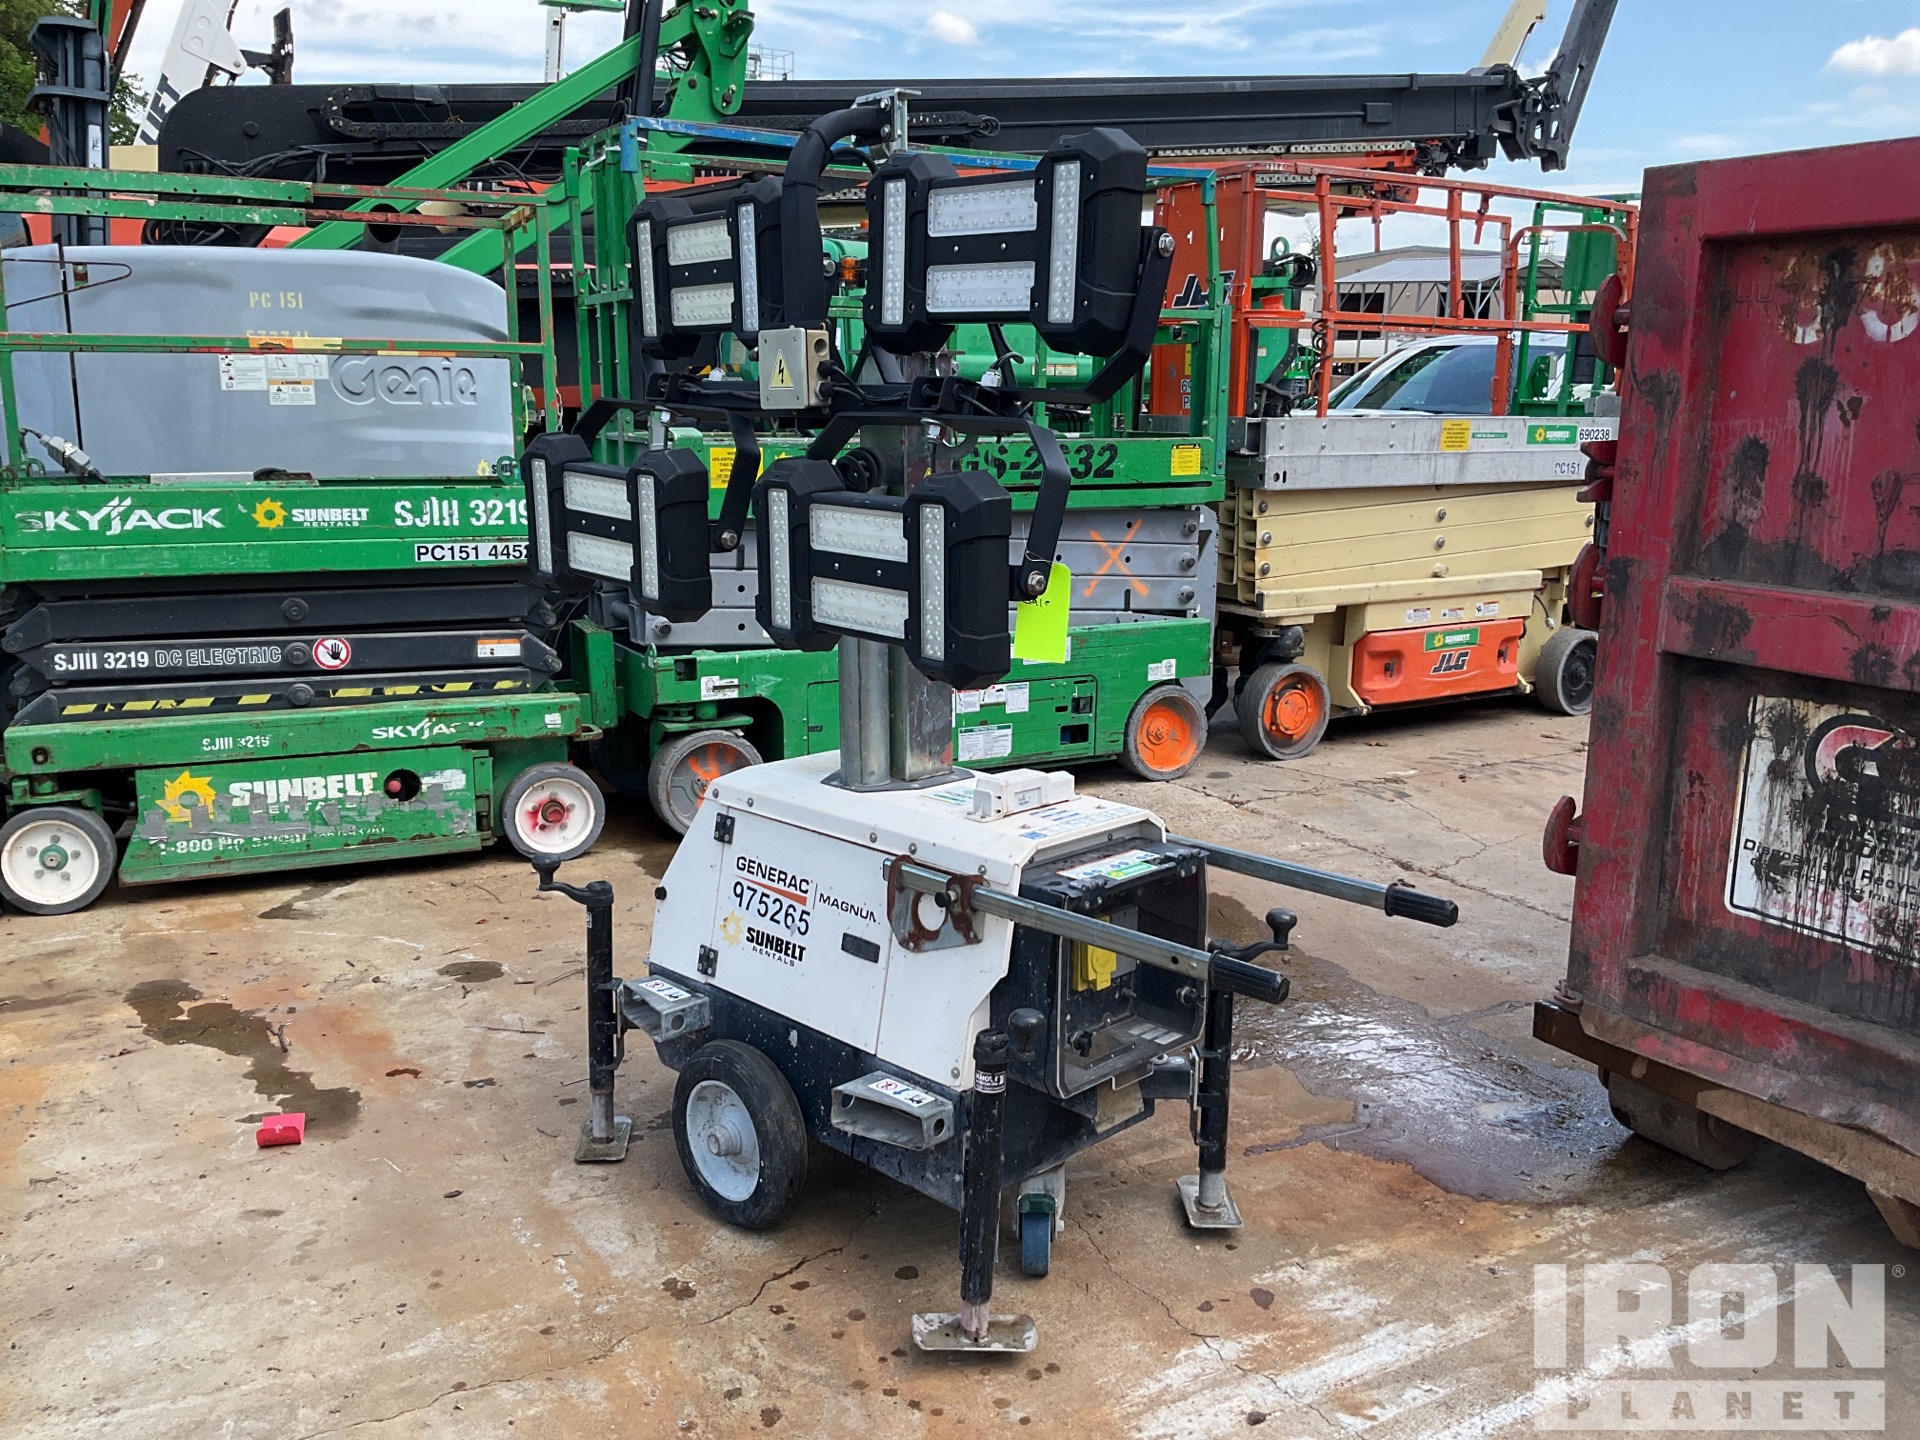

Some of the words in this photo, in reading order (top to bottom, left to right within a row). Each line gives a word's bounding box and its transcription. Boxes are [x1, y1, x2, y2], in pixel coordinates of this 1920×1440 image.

[249, 291, 271, 309] PC
[280, 292, 304, 309] 151
[330, 354, 478, 406] Genie
[1579, 428, 1611, 441] 690238
[14, 496, 226, 536] SKYJACK
[291, 507, 369, 522] SUNBELT
[416, 544, 480, 562] PC151
[53, 652, 98, 671] SJIII
[103, 649, 150, 669] 3219
[154, 649, 183, 667] DC
[186, 645, 282, 666] ELECTRIC
[1430, 650, 1471, 675] JLG
[372, 716, 484, 740] SKYJA
[228, 771, 378, 807] SUNBELT
[736, 856, 811, 895] GENERAC
[733, 880, 811, 936] 975265
[746, 926, 807, 962] SUNBELT
[752, 947, 796, 967] RENTALS
